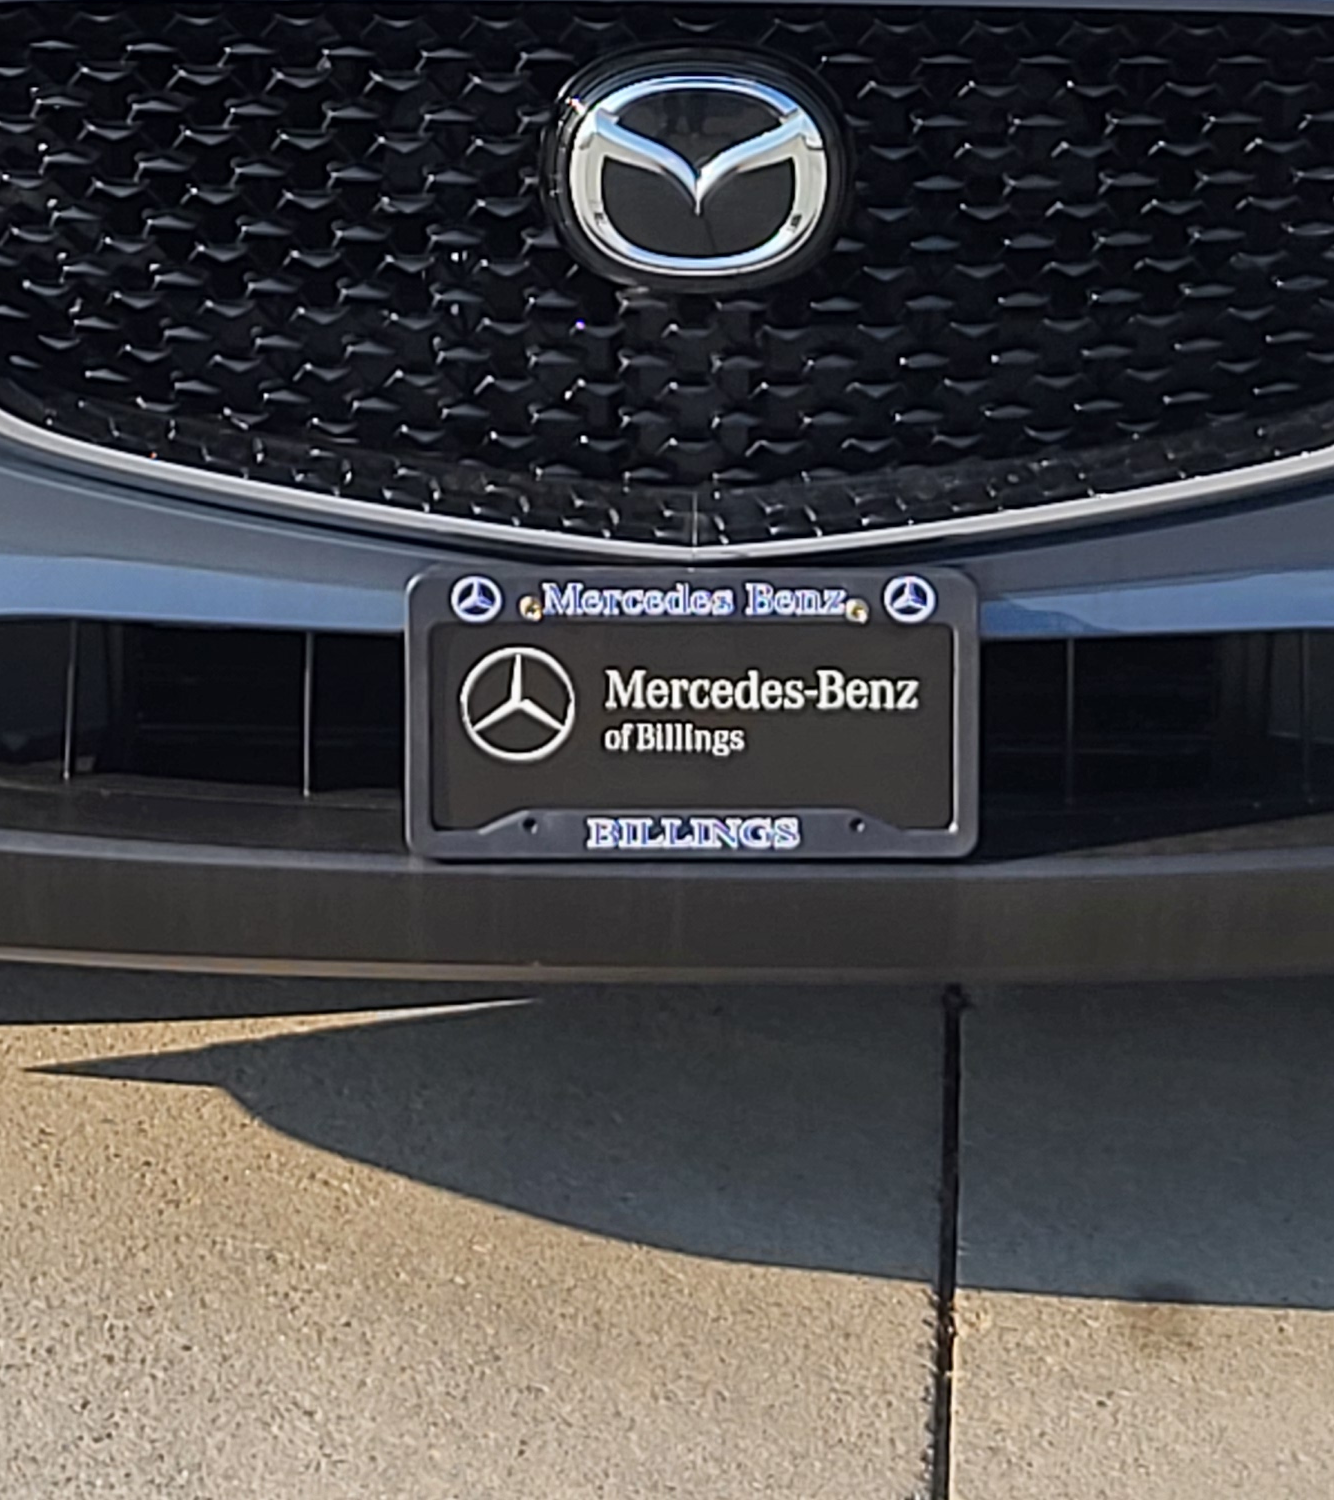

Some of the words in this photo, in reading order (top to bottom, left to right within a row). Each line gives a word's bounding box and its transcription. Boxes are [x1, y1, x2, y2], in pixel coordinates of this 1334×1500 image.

[542, 582, 735, 617] Mercedes
[746, 582, 847, 617] Benz
[604, 669, 920, 711] Mercedes-Benz
[604, 722, 632, 751] of
[636, 722, 746, 757] Billings
[586, 816, 802, 850] BILLINGS
